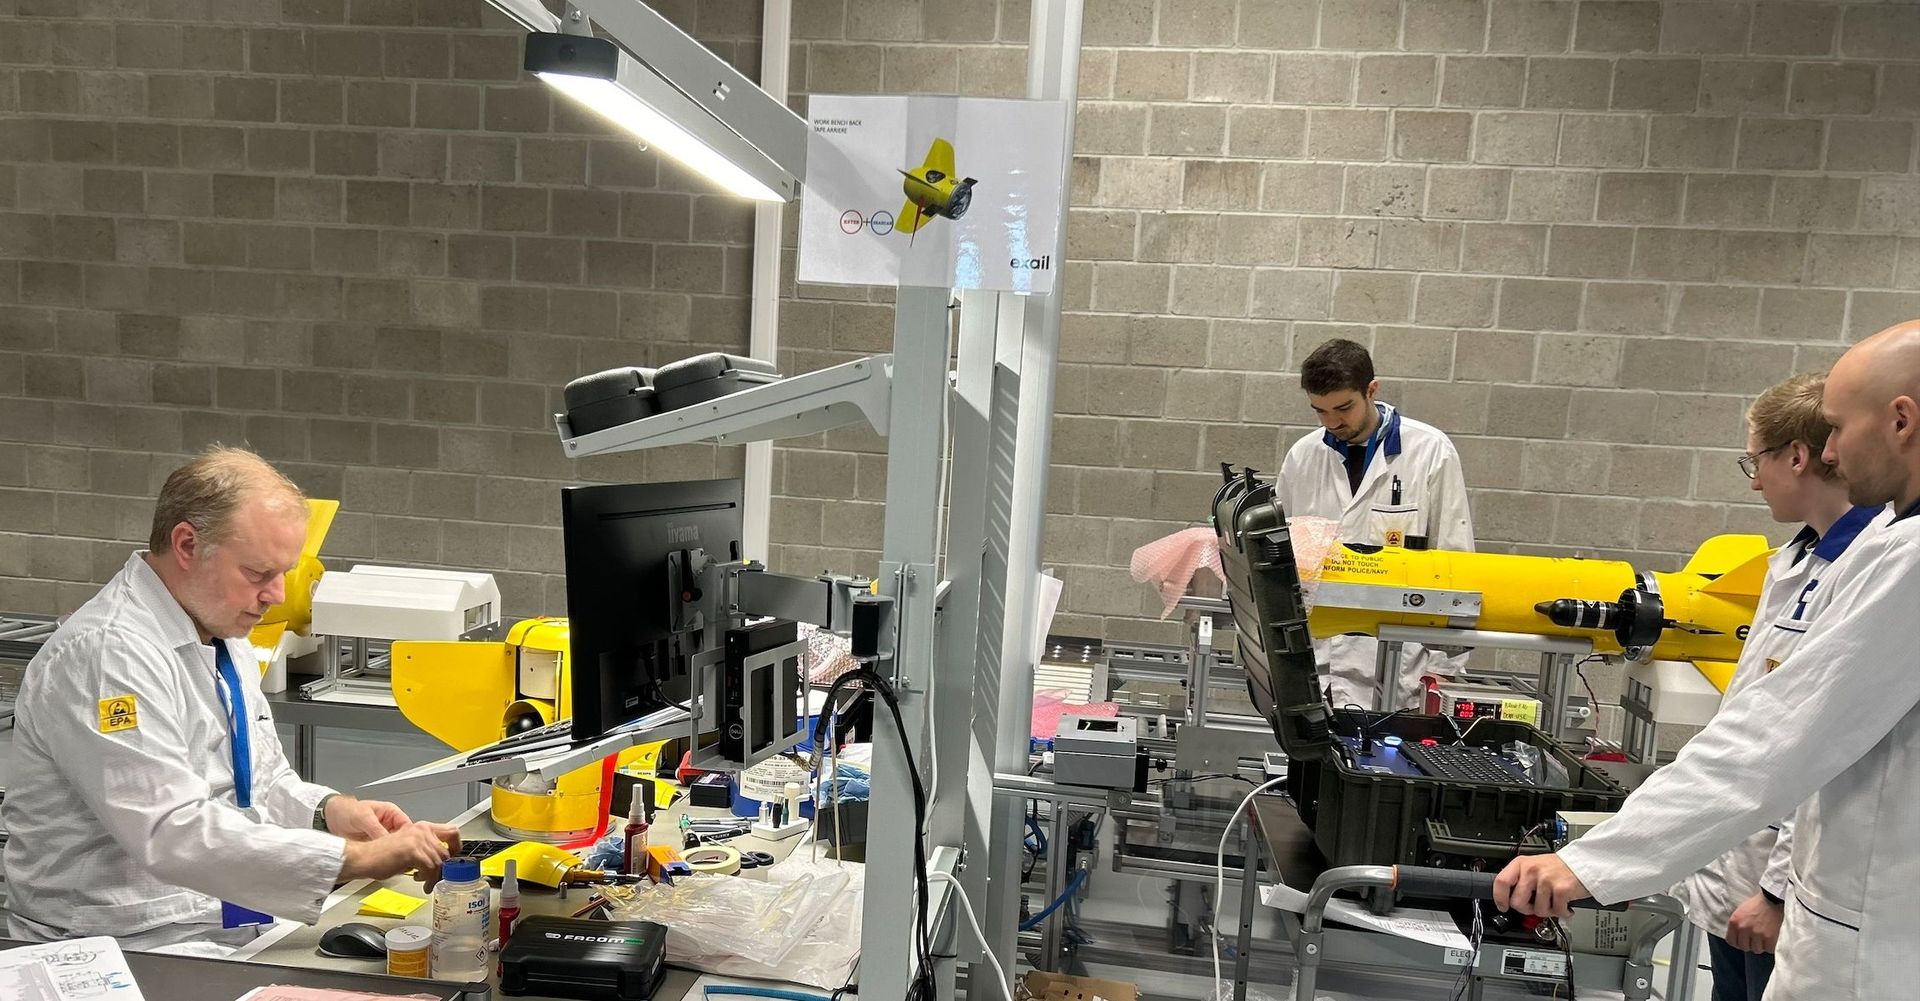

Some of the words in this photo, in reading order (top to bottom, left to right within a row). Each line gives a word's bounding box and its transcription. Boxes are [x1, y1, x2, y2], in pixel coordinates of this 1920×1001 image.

[831, 119, 848, 127] BENCH
[1010, 255, 1050, 270] exail
[1347, 567, 1389, 575] POLICE/NAVY
[110, 716, 131, 727] EPA
[564, 934, 625, 944] FACOM
